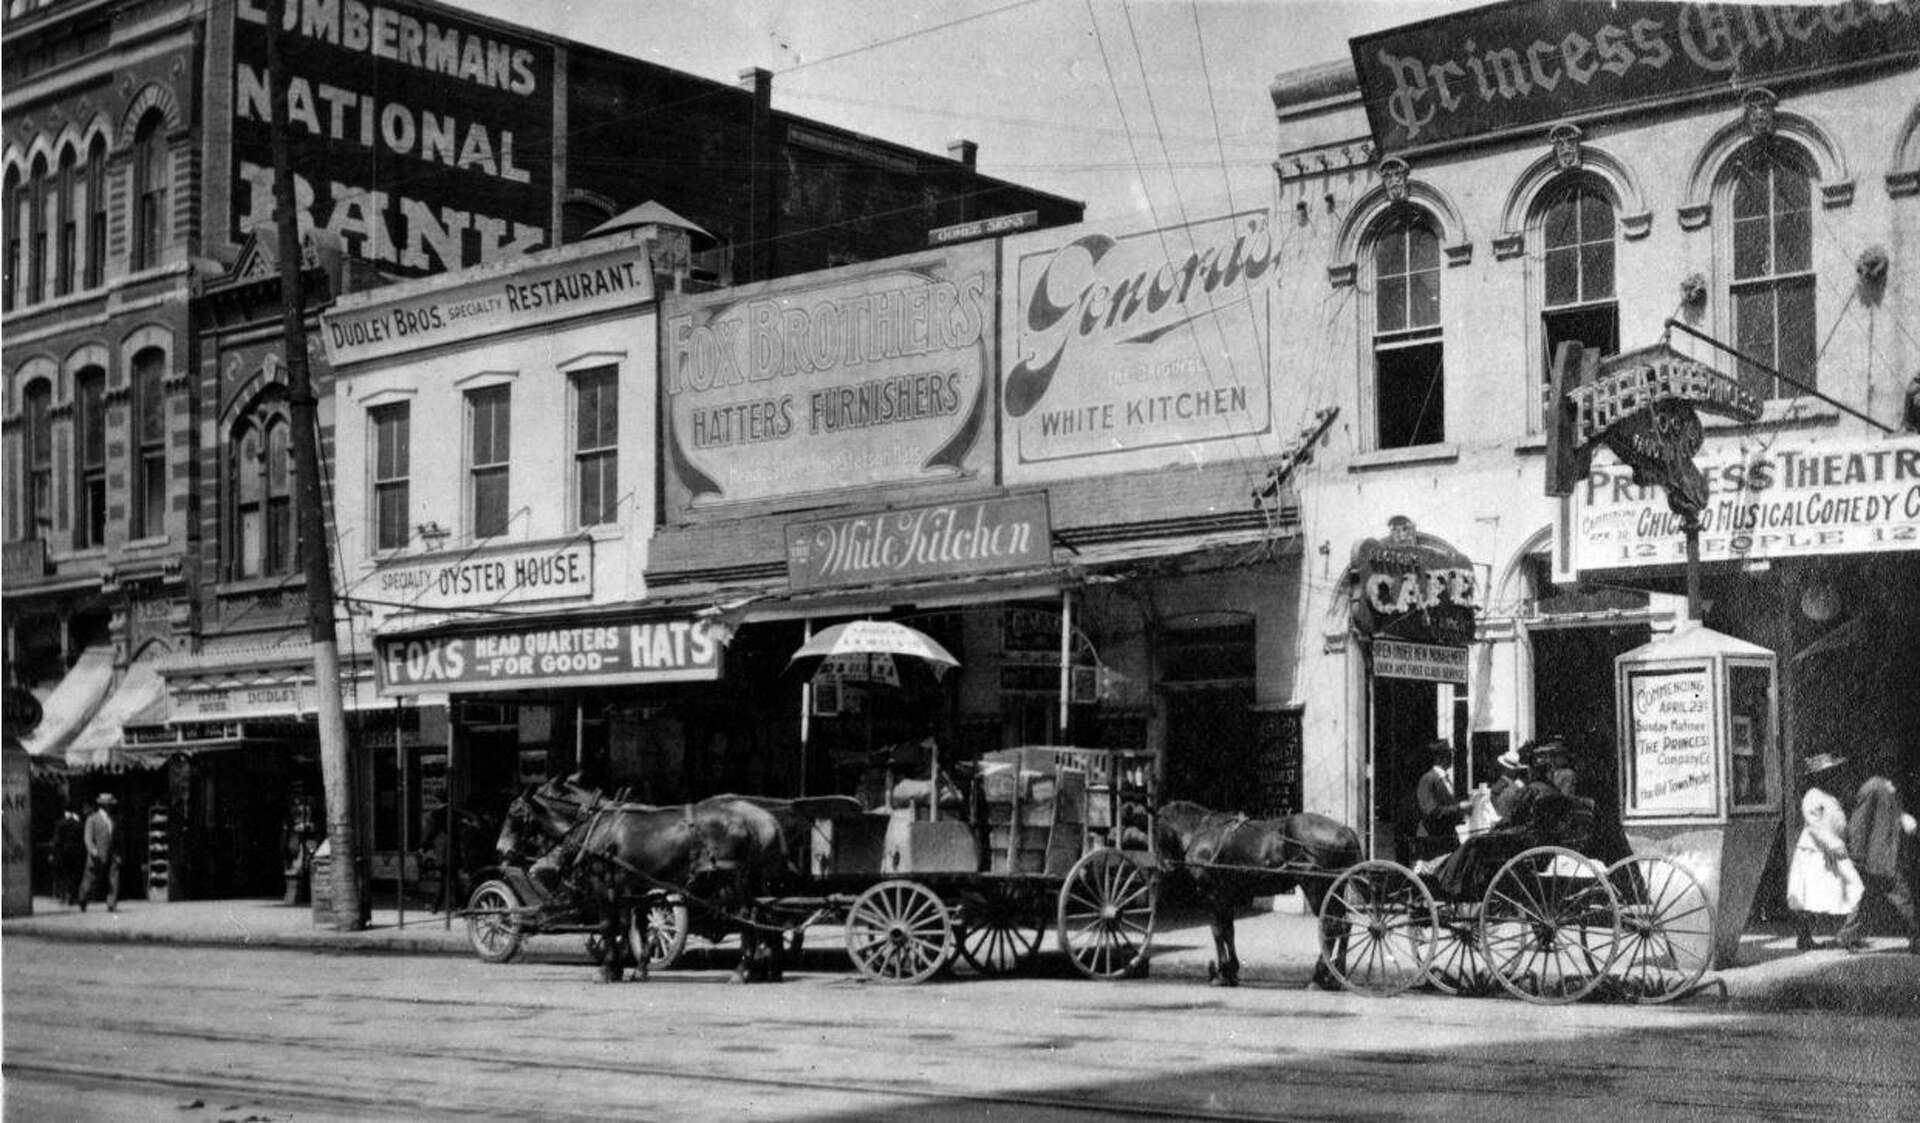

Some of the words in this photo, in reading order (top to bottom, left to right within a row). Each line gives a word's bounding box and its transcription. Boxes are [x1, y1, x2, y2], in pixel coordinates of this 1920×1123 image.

[1378, 17, 1673, 140] Princess
[237, 63, 531, 184] NATIONAL
[330, 315, 392, 350] DUDLEY
[394, 305, 447, 338] BROS.
[449, 299, 501, 321] SPECIALTY
[504, 261, 642, 313] RESTAURANT.
[667, 313, 744, 396] FOX
[749, 270, 986, 383] BROTHERS
[691, 396, 794, 448] HATTERS
[808, 370, 962, 435] FURNISHERS
[1041, 402, 1115, 438] WHITE
[1127, 385, 1247, 427] KITCHEN
[1716, 499, 1804, 532] MUSICAL
[1806, 492, 1900, 524] COMEDY
[816, 516, 897, 576] White
[897, 504, 1031, 571] Kitchen
[1620, 544, 1658, 559] 12
[1875, 525, 1917, 542] 12
[382, 568, 432, 592] SPECIALTY
[438, 562, 506, 596] OYSTER
[514, 552, 586, 588] HOUSE.
[1366, 567, 1475, 615] CAFE
[476, 633, 521, 658] HEAD
[524, 626, 620, 656] QUARTERS
[630, 621, 714, 668] HATS
[247, 689, 297, 704] DUDLEY
